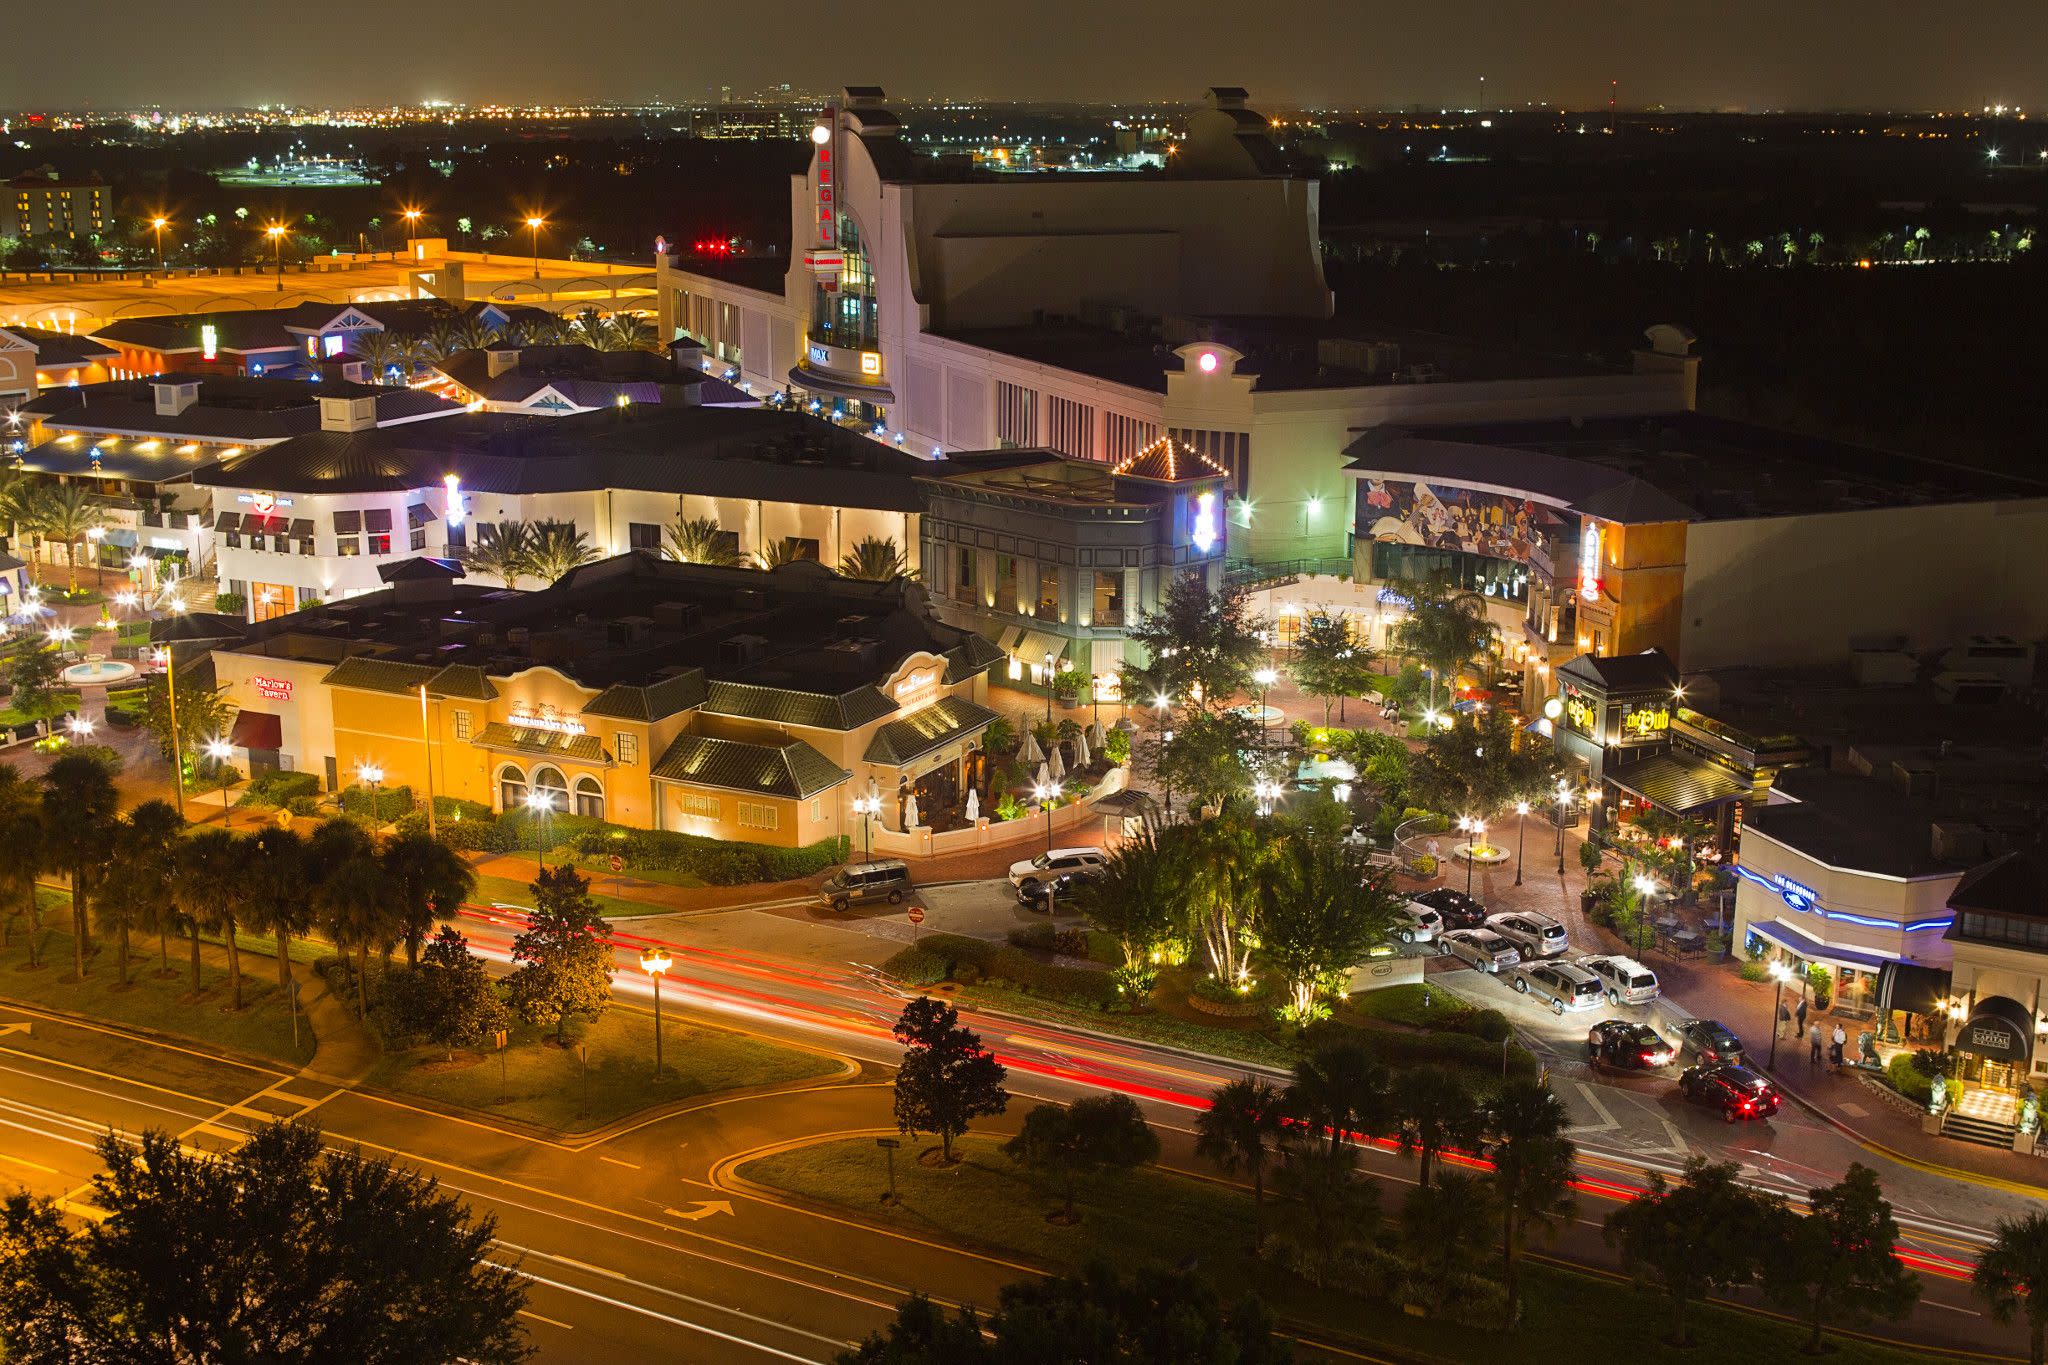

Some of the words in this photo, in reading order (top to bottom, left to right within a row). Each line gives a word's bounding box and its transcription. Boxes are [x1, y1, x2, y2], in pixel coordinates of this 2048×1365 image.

[819, 149, 832, 241] REGAL
[255, 677, 292, 690] Marlow's
[259, 687, 289, 700] Tavern
[1638, 707, 1669, 736] Pub
